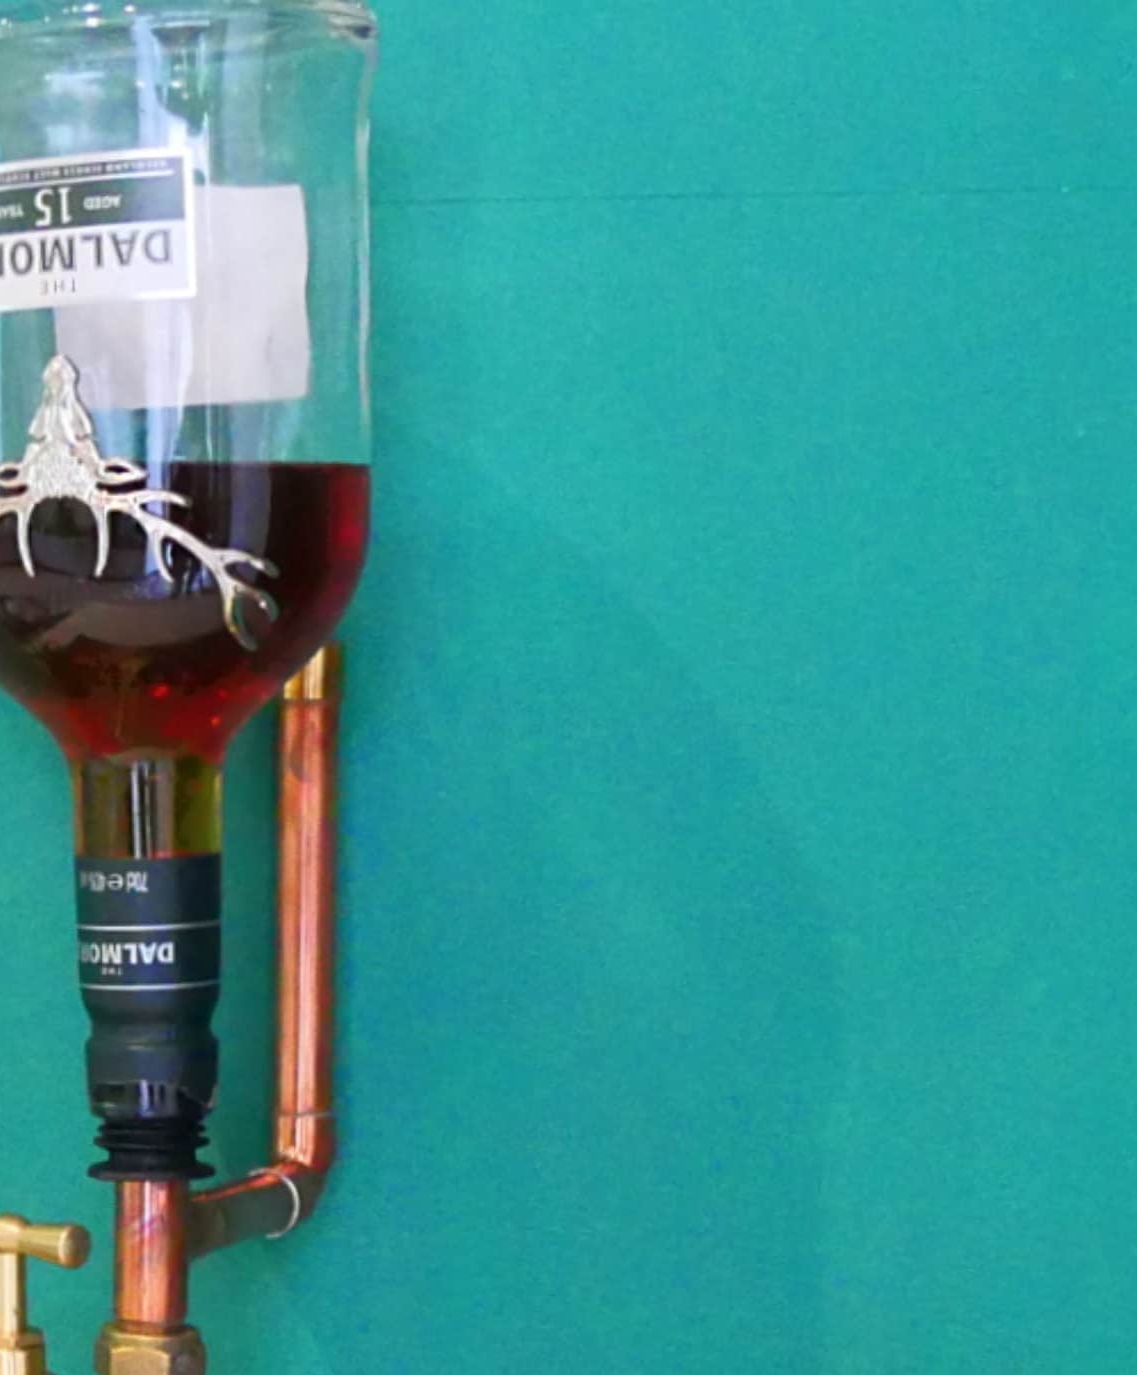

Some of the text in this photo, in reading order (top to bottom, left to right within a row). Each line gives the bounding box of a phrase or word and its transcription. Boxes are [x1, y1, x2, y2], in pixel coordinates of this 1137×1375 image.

[34, 186, 72, 226] 15
[83, 194, 122, 211] AGED
[41, 278, 76, 295] THE
[79, 942, 175, 965] DALMO
